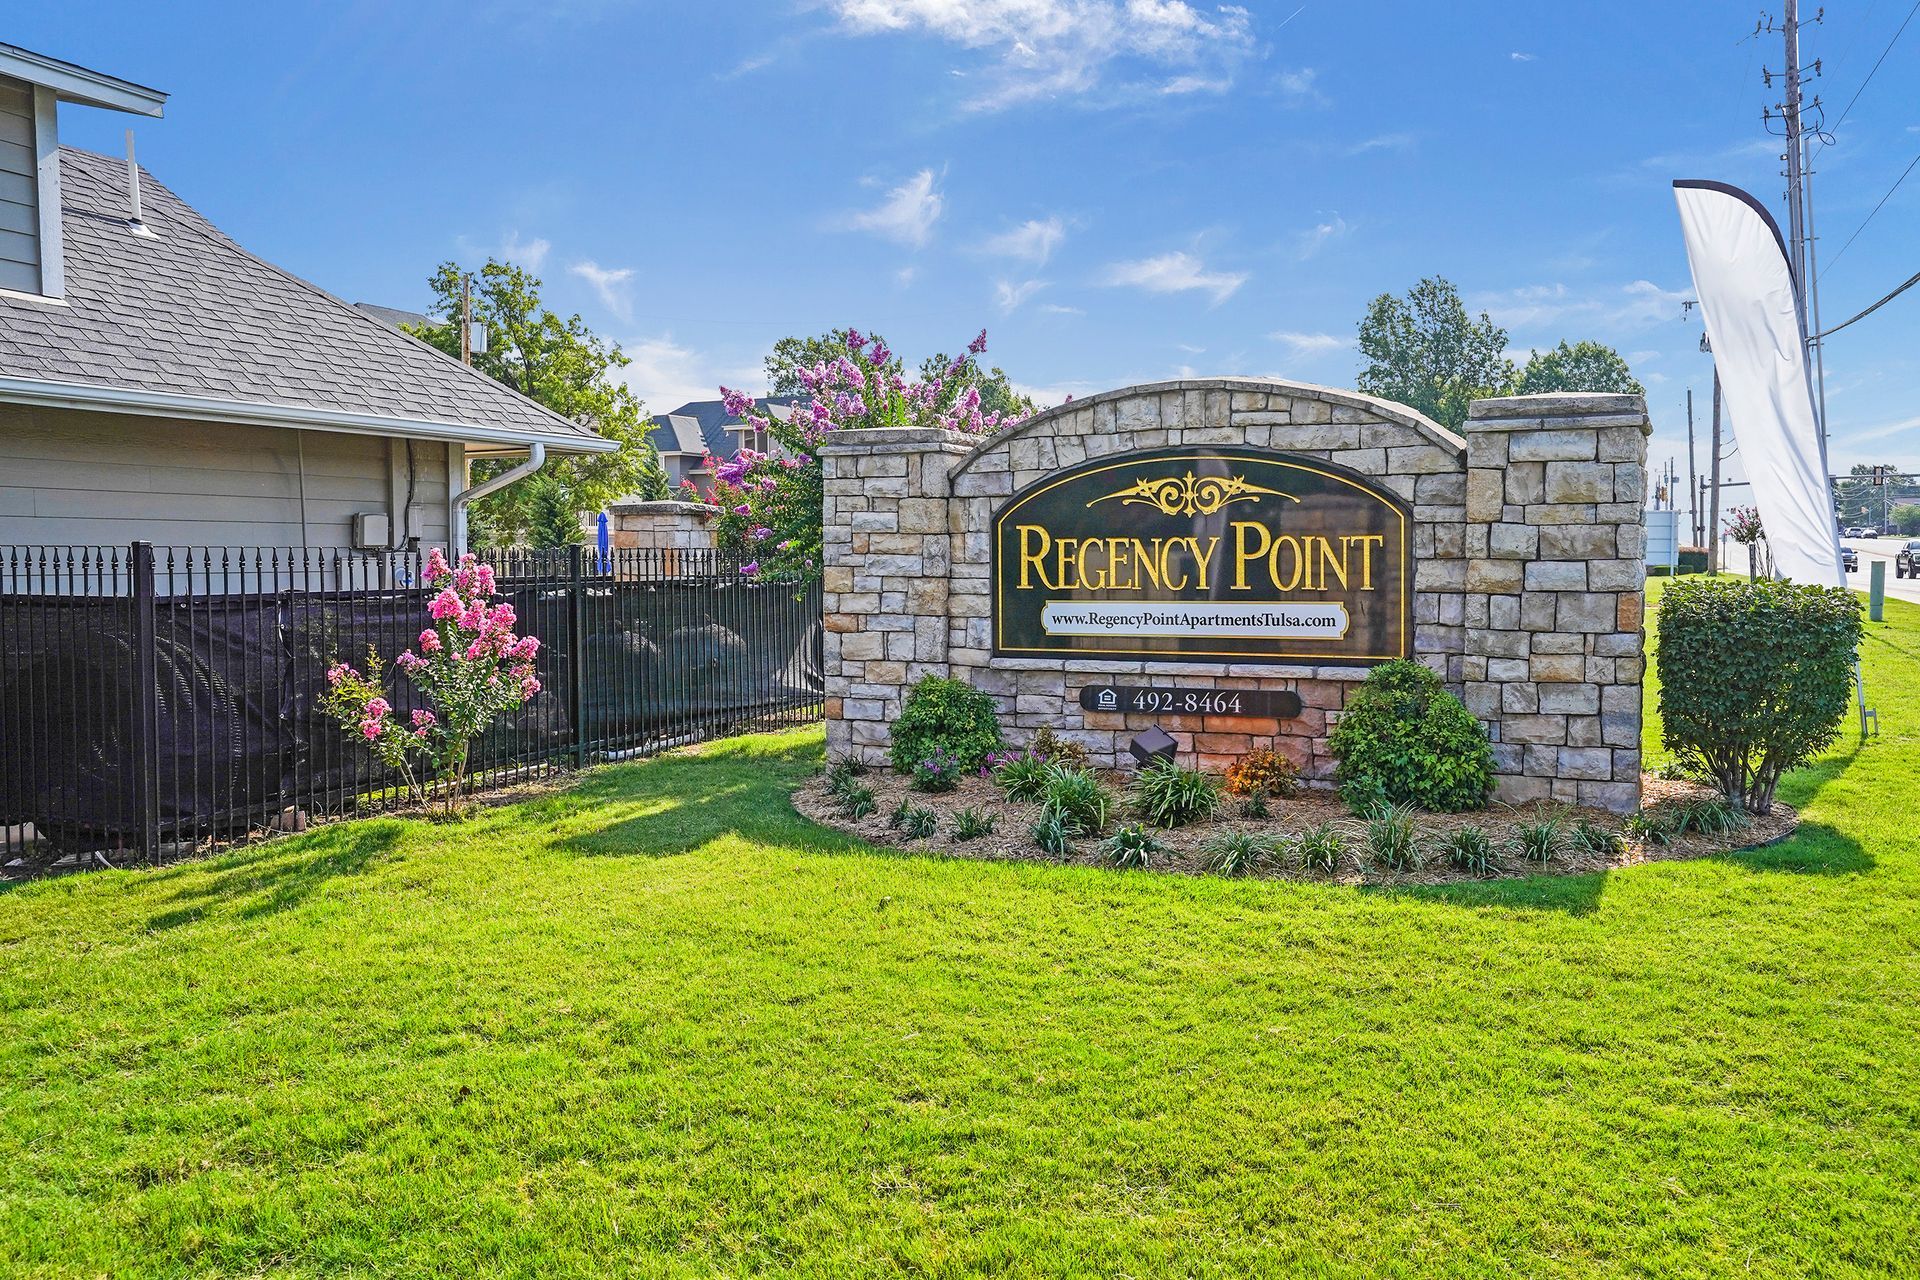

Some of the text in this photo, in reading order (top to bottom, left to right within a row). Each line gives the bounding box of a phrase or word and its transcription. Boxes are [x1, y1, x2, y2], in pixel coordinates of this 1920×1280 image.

[1016, 521, 1383, 591] REGENCY POINT
[1052, 611, 1337, 629] www.RegencyPointApartmentsTulsa.com
[1133, 690, 1242, 713] 492-8464
